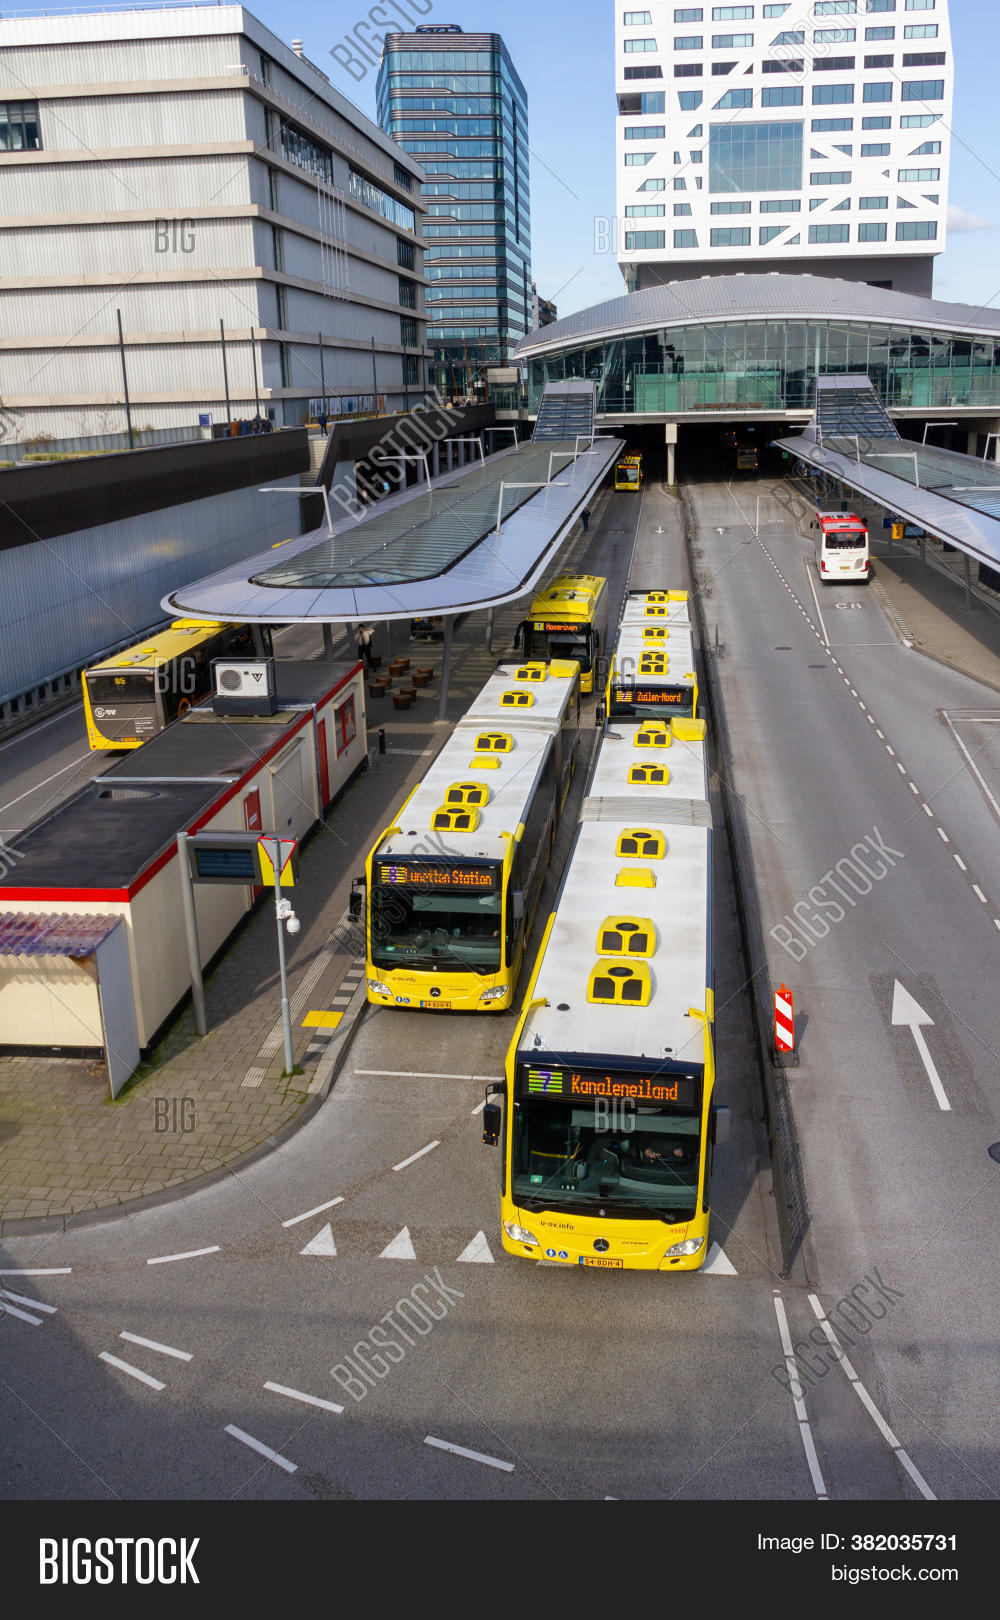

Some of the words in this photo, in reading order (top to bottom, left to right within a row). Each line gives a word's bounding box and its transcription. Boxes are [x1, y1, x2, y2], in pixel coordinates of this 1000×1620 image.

[637, 691, 682, 703] Zuilen-Noord
[404, 867, 450, 884] Lunetten
[452, 869, 492, 886] Station
[571, 1073, 678, 1100] Kanaleneiland
[540, 1220, 574, 1231] u-ov.info
[585, 1258, 620, 1268] 54-BDH-4
